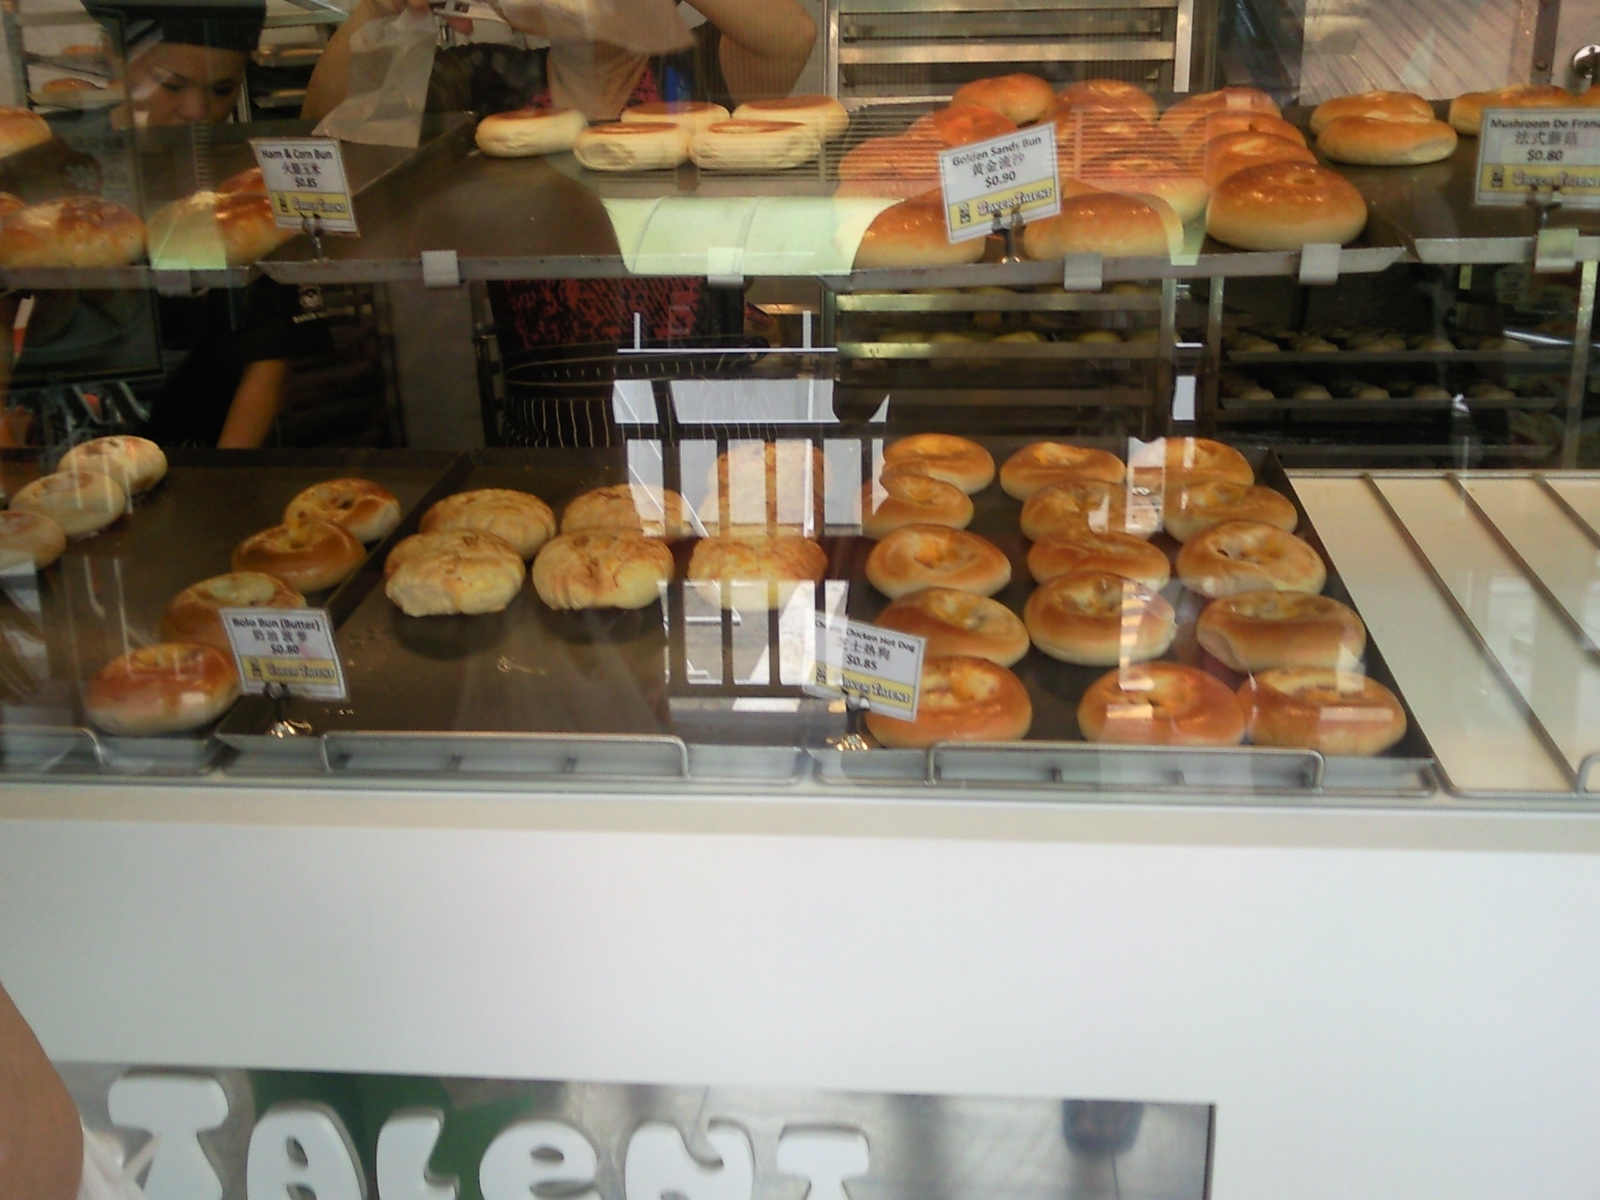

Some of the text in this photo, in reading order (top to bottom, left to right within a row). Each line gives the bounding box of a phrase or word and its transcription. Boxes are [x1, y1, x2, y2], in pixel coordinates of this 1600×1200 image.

[1490, 118, 1550, 128] Mushroom
[1553, 119, 1569, 128] De
[262, 149, 333, 160] Ham & Corn Bun
[952, 136, 1042, 166] Golden Sands Bun
[1527, 149, 1564, 161] $0.80
[295, 177, 317, 188] $0.85
[985, 171, 1016, 188] $0.90
[232, 618, 320, 632] Bolo Bun (Butter)
[846, 628, 916, 653] Chicken Hot Dog
[271, 642, 300, 655] $0.80
[846, 655, 877, 671] $0.85
